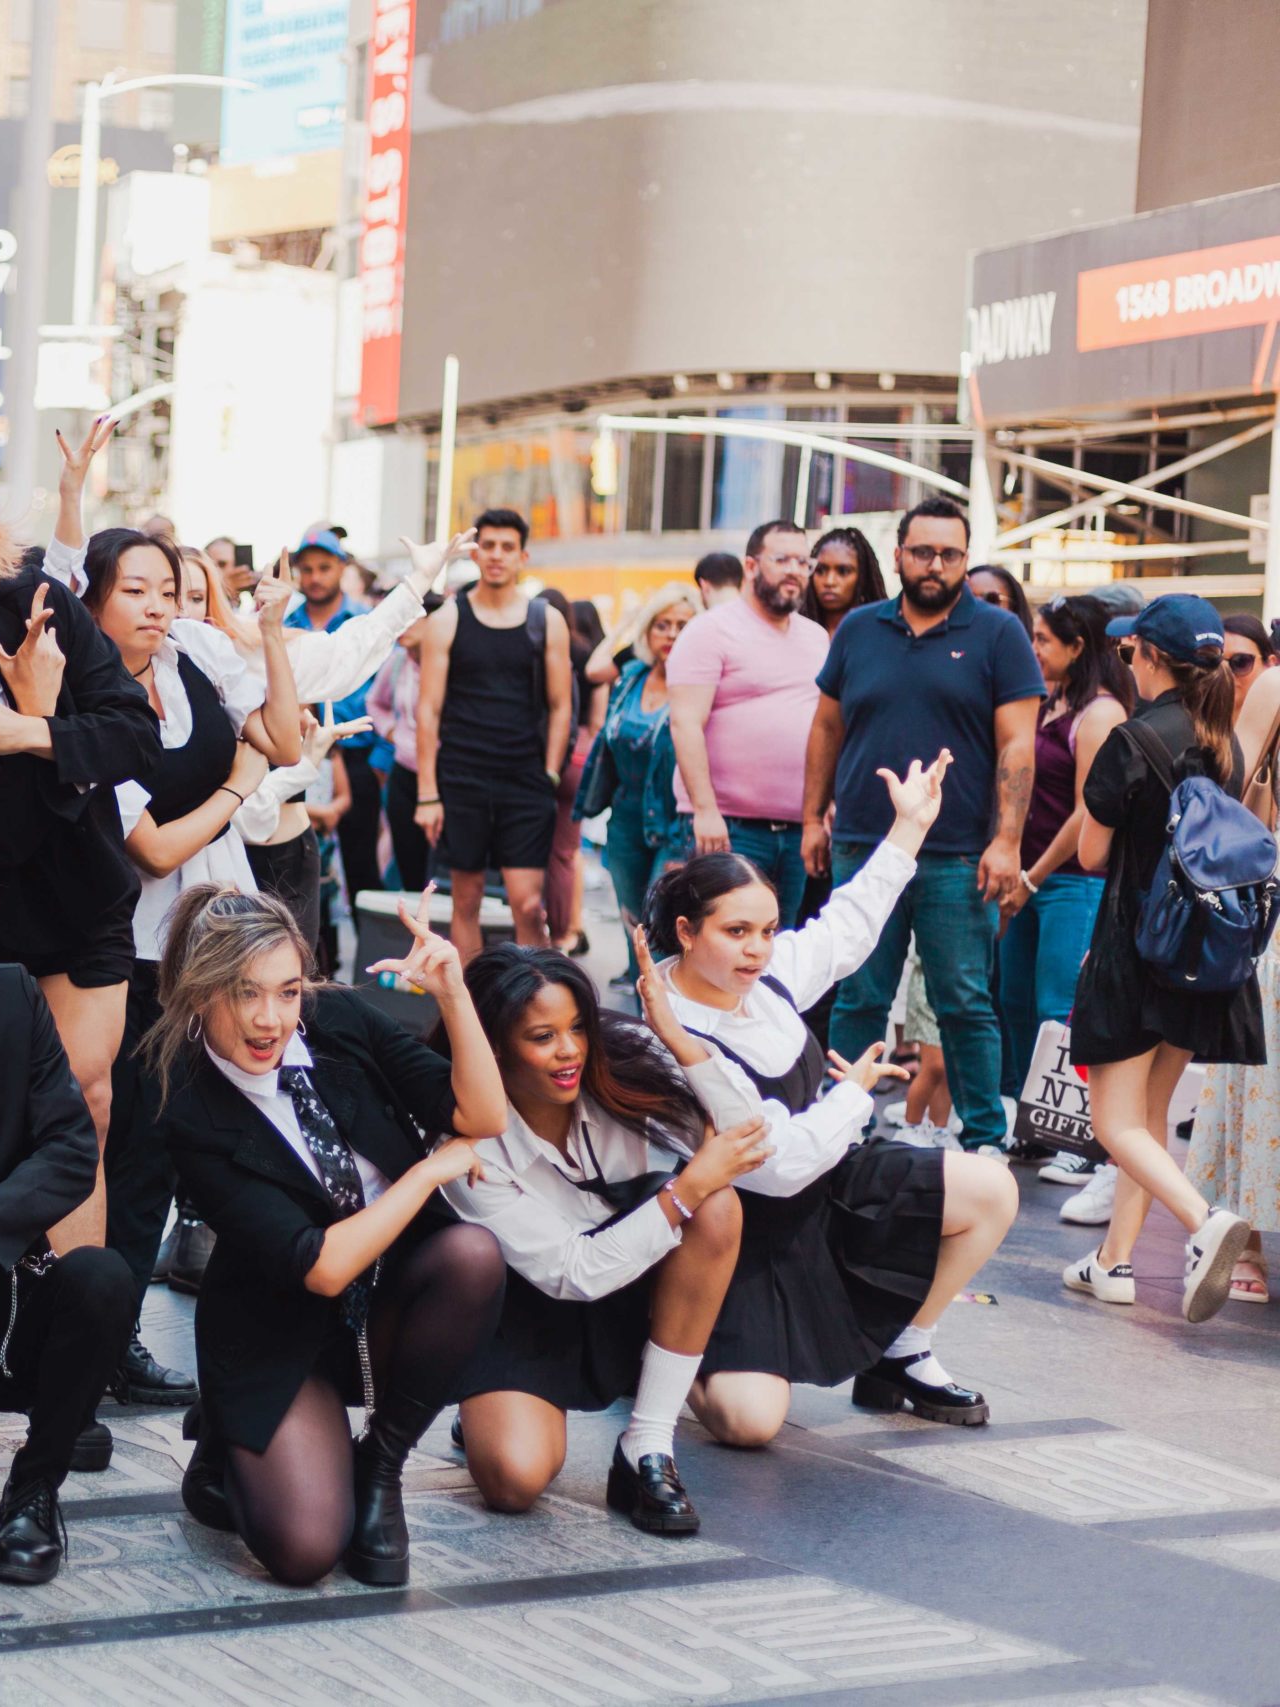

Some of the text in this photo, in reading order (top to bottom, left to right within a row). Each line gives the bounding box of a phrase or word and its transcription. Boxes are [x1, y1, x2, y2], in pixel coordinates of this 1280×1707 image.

[361, 0, 411, 341] EY'S STORE
[1116, 279, 1170, 323] 1568
[1035, 1074, 1091, 1117] NY
[1029, 1108, 1096, 1141] GIFTS
